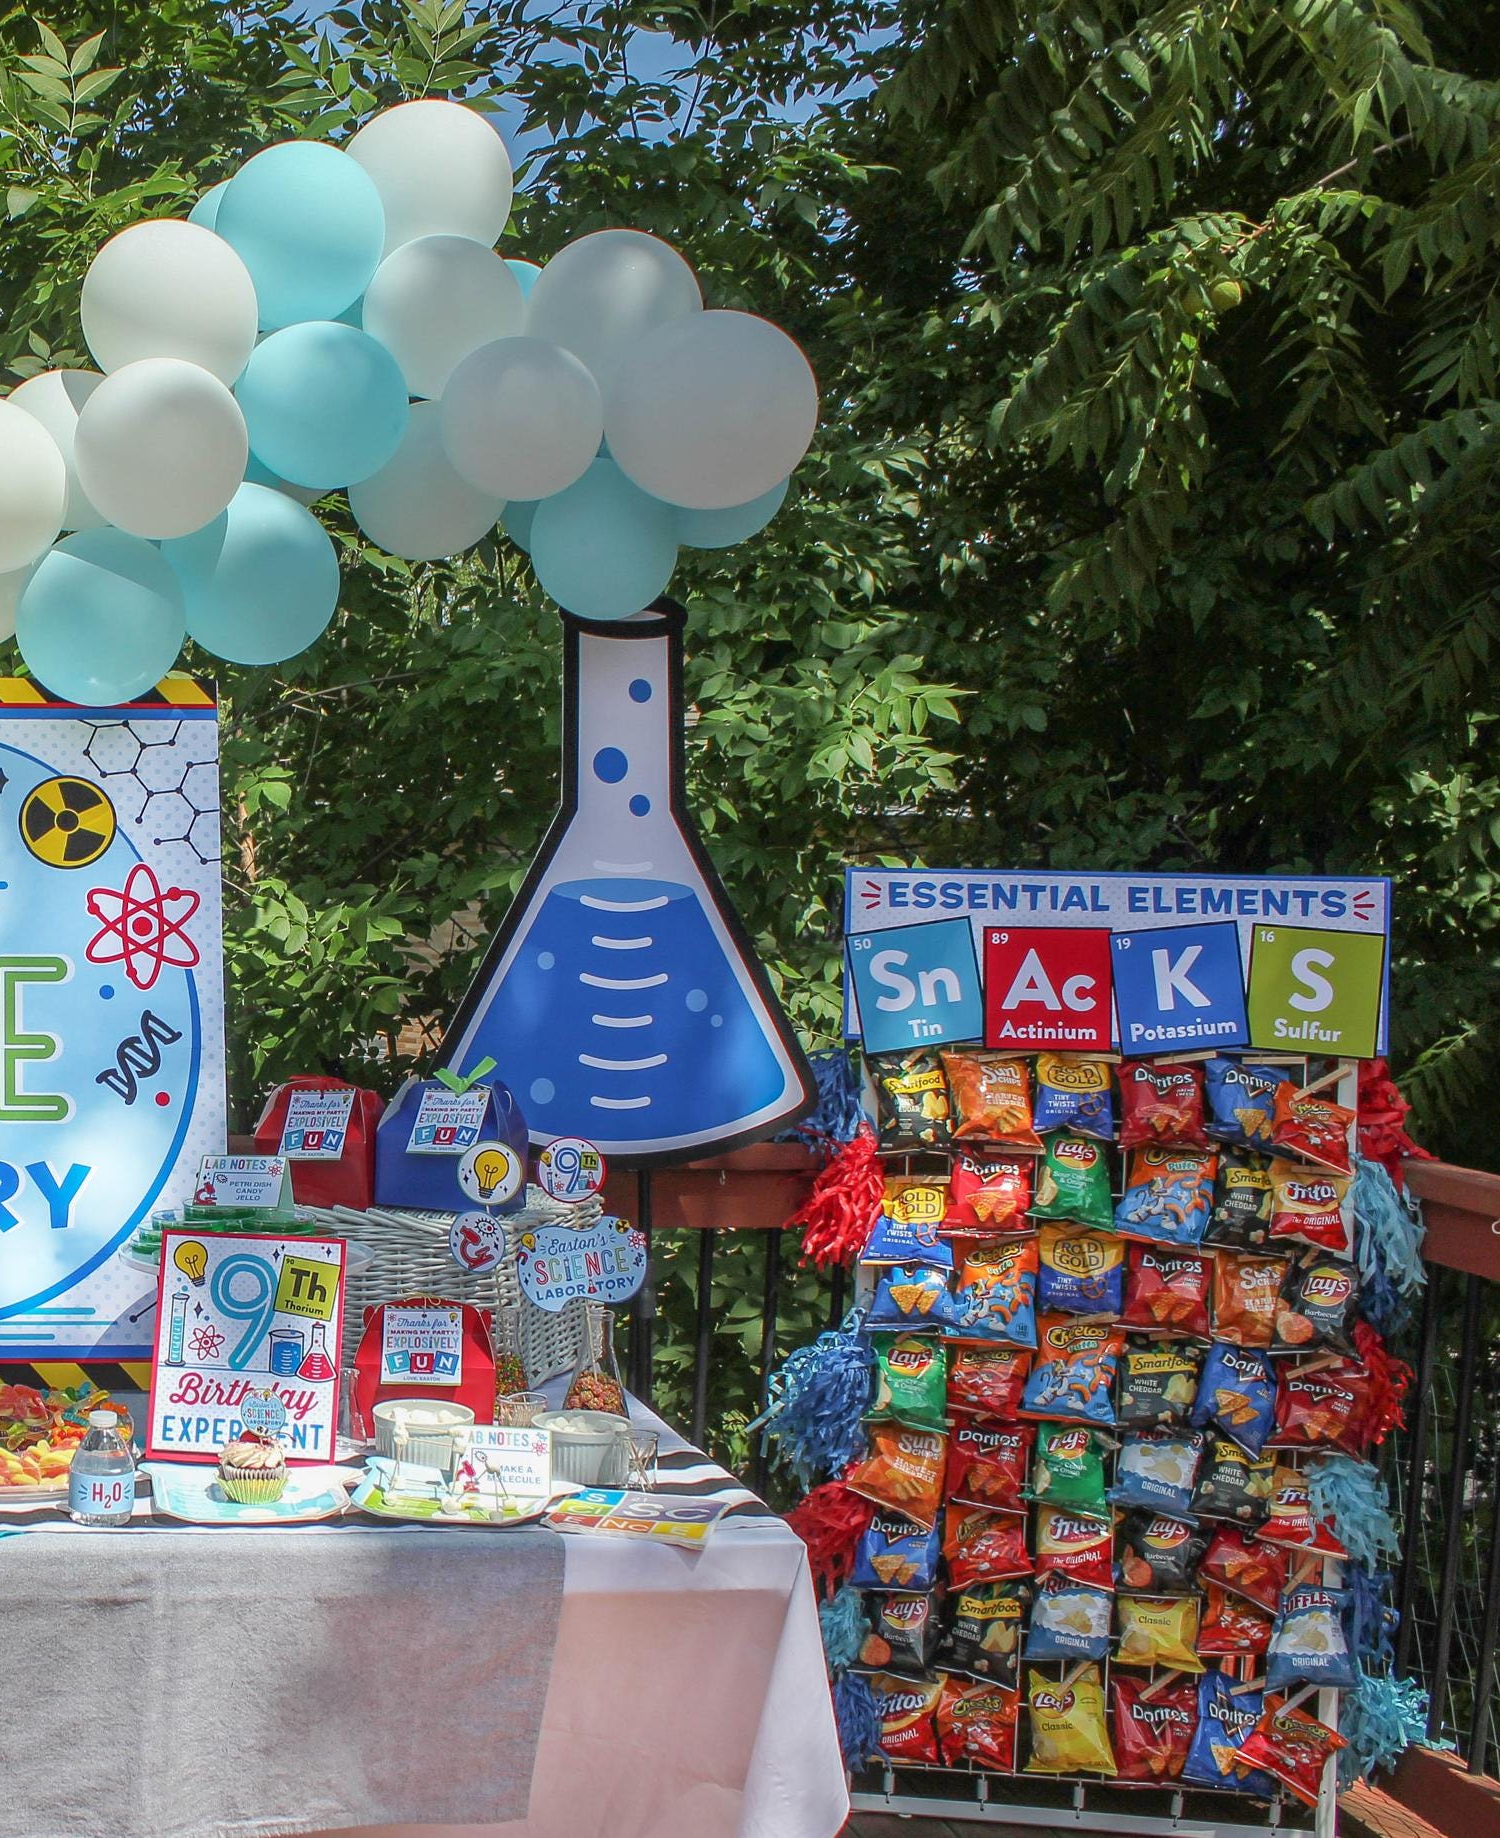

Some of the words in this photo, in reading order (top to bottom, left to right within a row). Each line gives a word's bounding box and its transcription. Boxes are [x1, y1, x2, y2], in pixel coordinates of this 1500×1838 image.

[888, 881, 1109, 912] ESSENTIAL
[1128, 886, 1347, 918] ELEMENTS
[854, 938, 871, 950] 50
[991, 932, 1009, 945] 89
[1116, 937, 1131, 950] 19
[1260, 931, 1275, 943] 16
[869, 950, 961, 1012] Sn
[1001, 948, 1097, 1012] Ac
[1151, 945, 1212, 1011] K
[1288, 948, 1335, 1013] S
[907, 1018, 943, 1038] Tin
[1000, 1019, 1097, 1041] Actinium
[1130, 1018, 1237, 1042] Potassium
[1274, 1018, 1342, 1042] Sulfur
[1055, 1074, 1096, 1085] GOLD
[1134, 1068, 1194, 1089] Doritos
[327, 1100, 340, 1109] for
[1047, 1100, 1076, 1108] TWISTS
[1056, 1142, 1094, 1161] Lay's
[205, 1159, 226, 1169] LAB
[230, 1159, 266, 1170] NOTES
[583, 1155, 597, 1165] Th
[962, 1158, 1019, 1177] Doritos
[1230, 1192, 1253, 1202] WHITE
[1286, 1180, 1338, 1200] Fritos
[1224, 1200, 1258, 1211] CHEDDAR
[1303, 1215, 1341, 1225] ORIGINAL
[886, 1229, 913, 1238] TWISTS
[549, 1233, 608, 1256] Easton's
[882, 1237, 914, 1245] ORIGINAL
[1061, 1243, 1098, 1254] ROLD
[1058, 1254, 1099, 1268] GOLD
[1142, 1254, 1202, 1273] Doritos
[290, 1267, 326, 1303] Th
[1051, 1283, 1077, 1291] TWISTS
[1305, 1277, 1347, 1297] Lay's
[210, 1253, 279, 1371] 9
[284, 1300, 324, 1316] Thorium
[1304, 1309, 1338, 1319] Barbecue
[397, 1318, 431, 1327] Thanks
[432, 1318, 449, 1329] for
[387, 1336, 459, 1349] EXPLOSIVELY
[1048, 1327, 1109, 1347] Cheetos
[889, 1350, 932, 1369] Lay's
[1128, 1385, 1162, 1394] CHEDDAR
[1134, 1378, 1158, 1387] WHITE
[468, 1433, 483, 1445] AB
[488, 1432, 529, 1447] NOTES
[899, 1434, 941, 1453] Sun
[958, 1430, 1020, 1447] Doritos
[912, 1448, 941, 1461] CHIPS
[527, 1466, 533, 1474] A
[1218, 1466, 1241, 1477] WHITE
[1212, 1473, 1245, 1487] CHEDDAR
[1141, 1480, 1176, 1498] ORIGINAL
[1145, 1519, 1185, 1540] Lay's
[1066, 1550, 1102, 1563] ORIGINAL
[1144, 1551, 1175, 1561] Barbecue
[961, 1602, 1018, 1615] Smartfood
[957, 1621, 979, 1633] WHITE
[1138, 1615, 1171, 1626] Classic
[952, 1627, 981, 1641] CHEDDAR
[1054, 1635, 1090, 1649] ORIGINAL
[1292, 1657, 1330, 1667] ORIGINAL
[1132, 1704, 1189, 1723] Doritos
[1041, 1722, 1073, 1731] Classic
[882, 1728, 919, 1744] ORIGINAL
